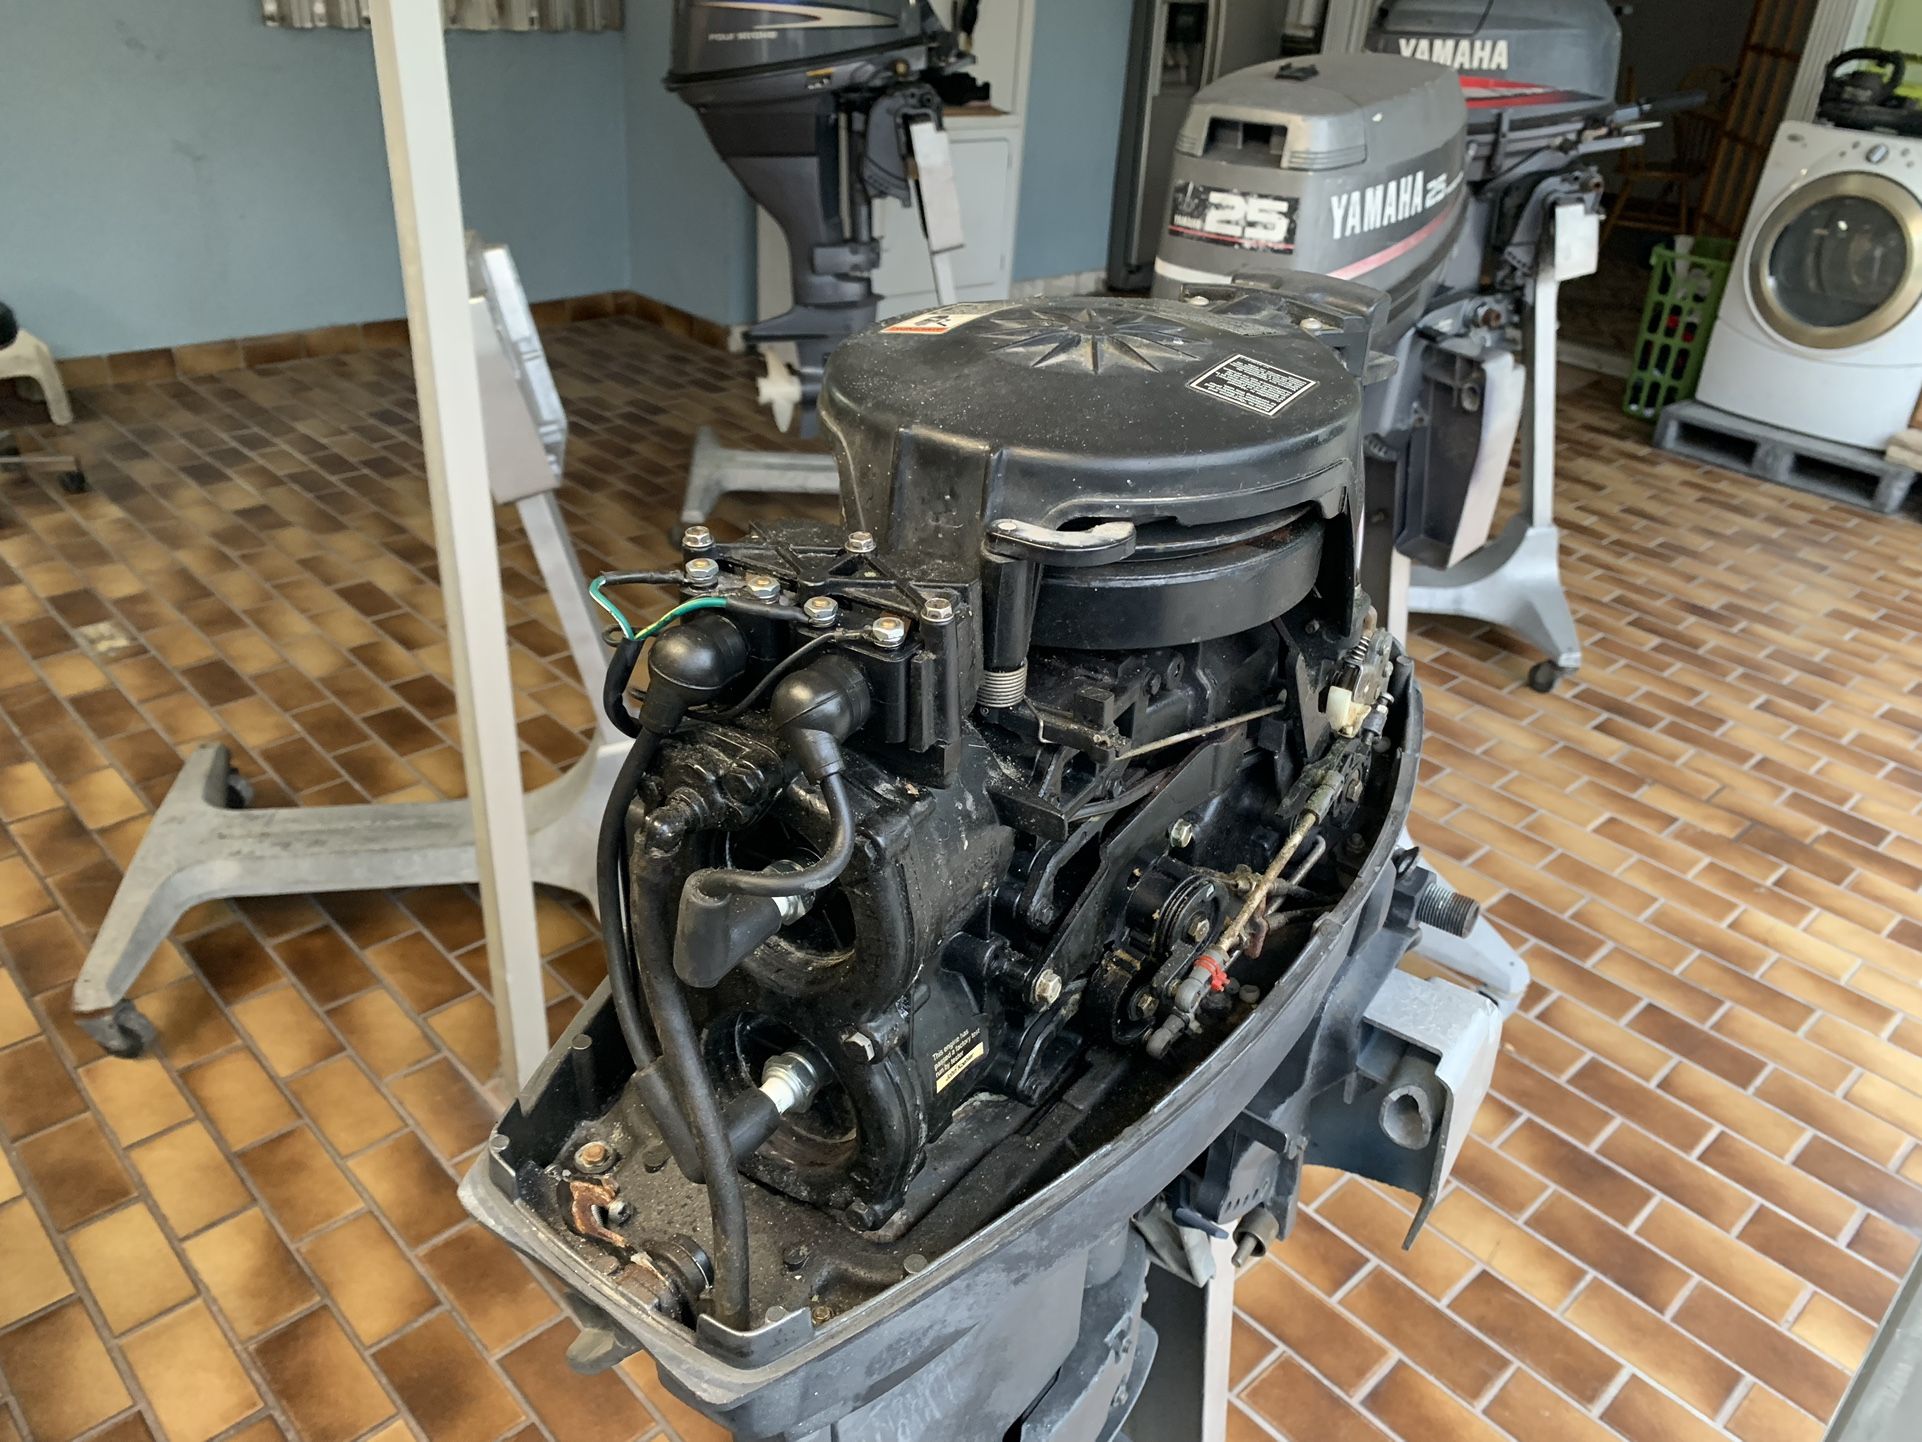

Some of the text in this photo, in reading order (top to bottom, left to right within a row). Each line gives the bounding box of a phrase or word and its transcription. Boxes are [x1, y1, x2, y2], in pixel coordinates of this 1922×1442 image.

[1398, 37, 1509, 71] YAMAHA
[1203, 190, 1290, 244] 25
[1330, 170, 1448, 240] YAMAHA 25
[932, 1049, 944, 1061] This
[943, 1036, 960, 1053] engine
